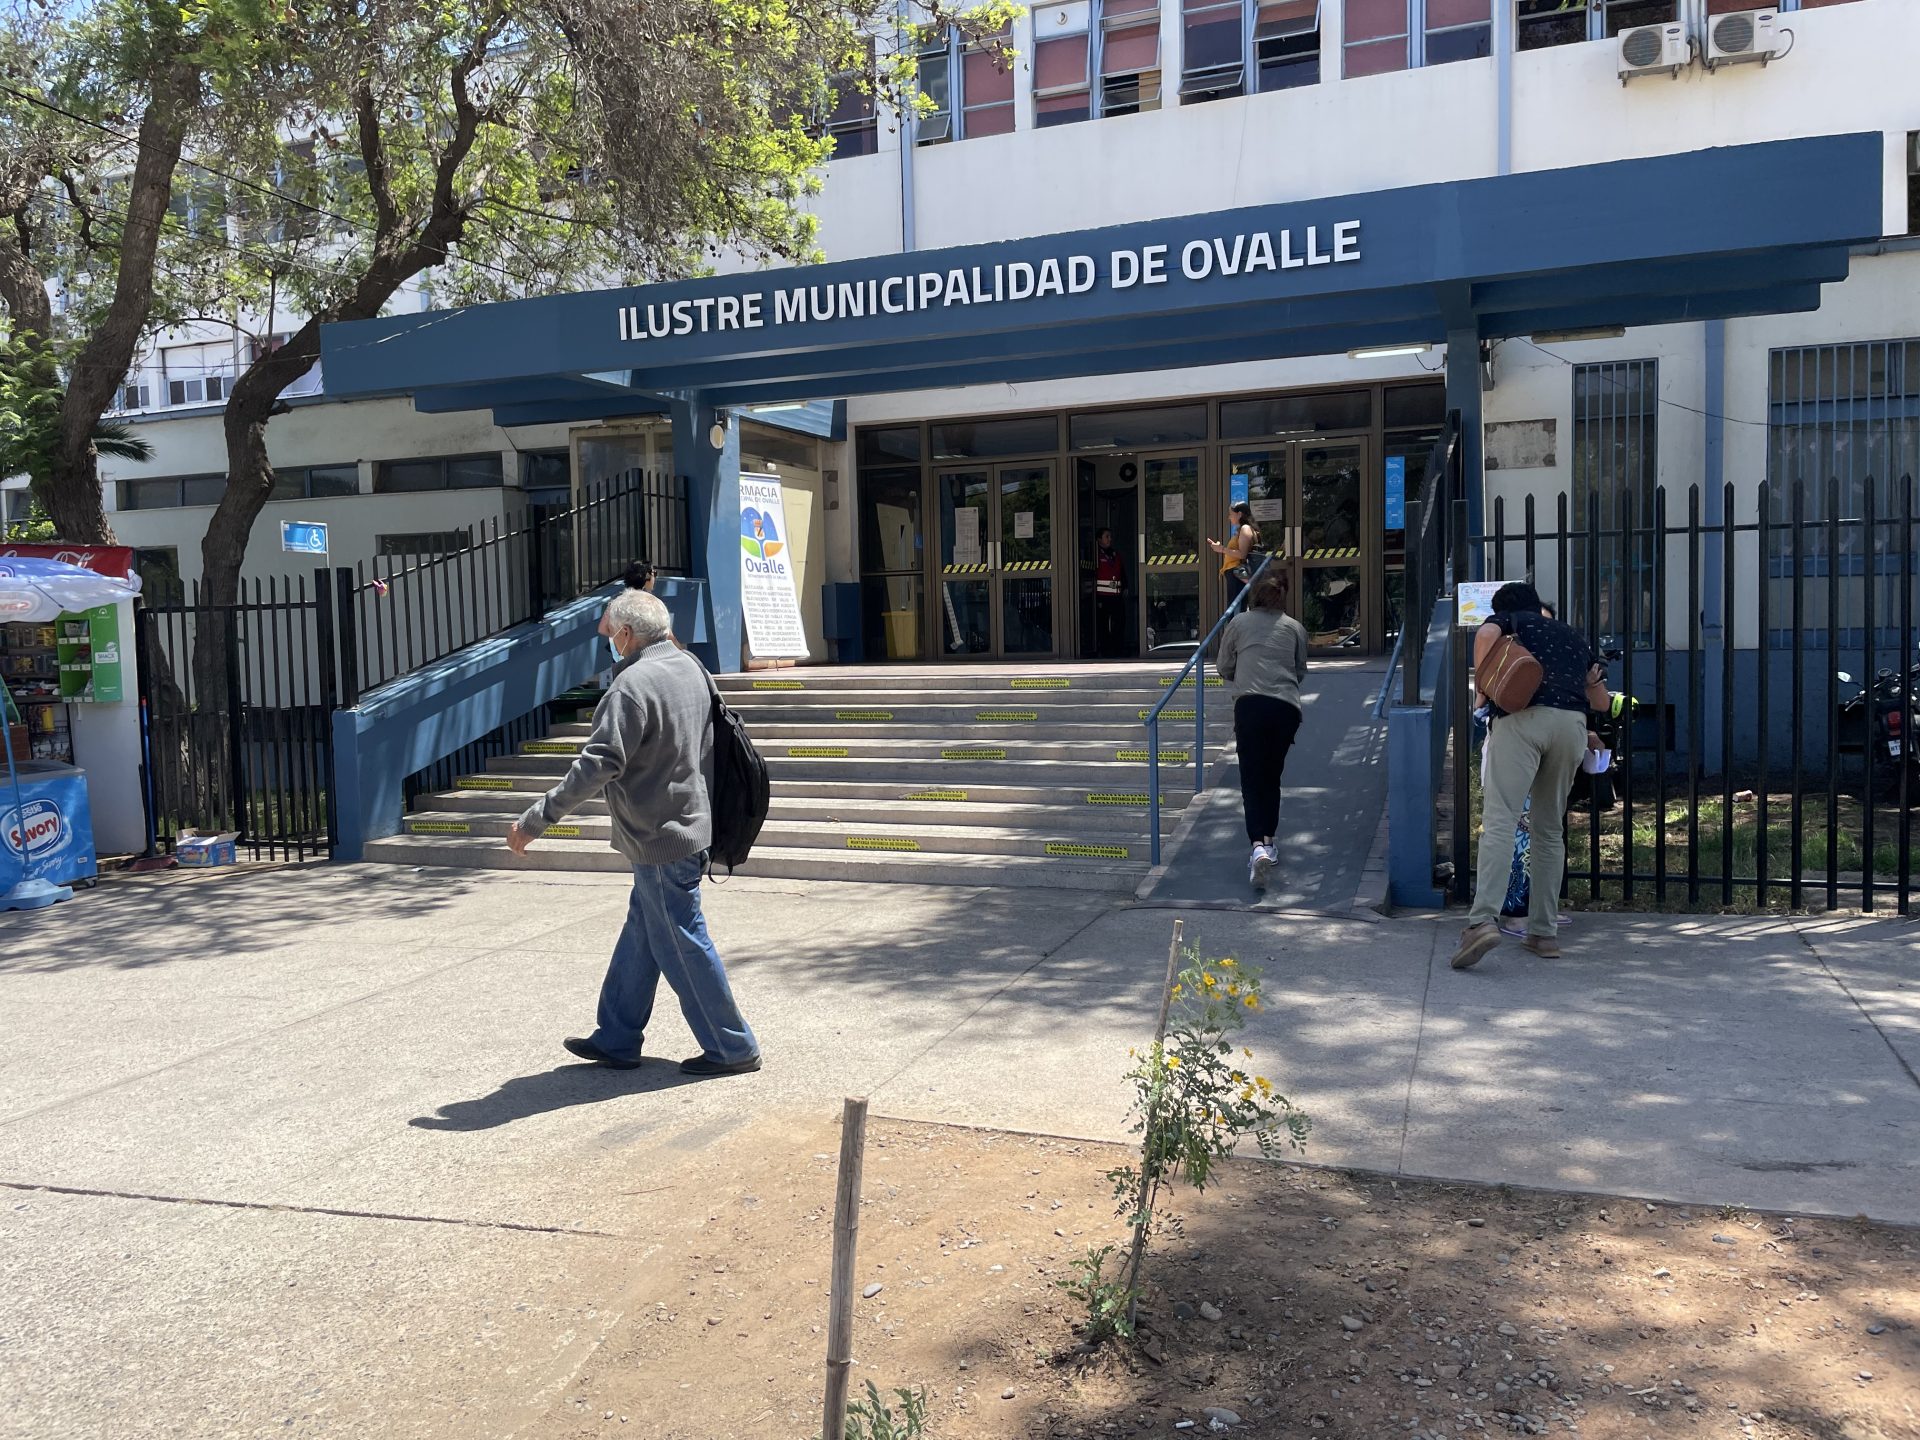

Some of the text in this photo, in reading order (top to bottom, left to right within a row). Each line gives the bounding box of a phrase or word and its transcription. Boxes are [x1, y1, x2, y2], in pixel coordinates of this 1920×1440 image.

[619, 219, 1361, 341] ILUSTRE MUNICIPALIDAD DE OVALLE
[740, 485, 778, 498] RMACIA
[745, 557, 785, 574] Ovalle
